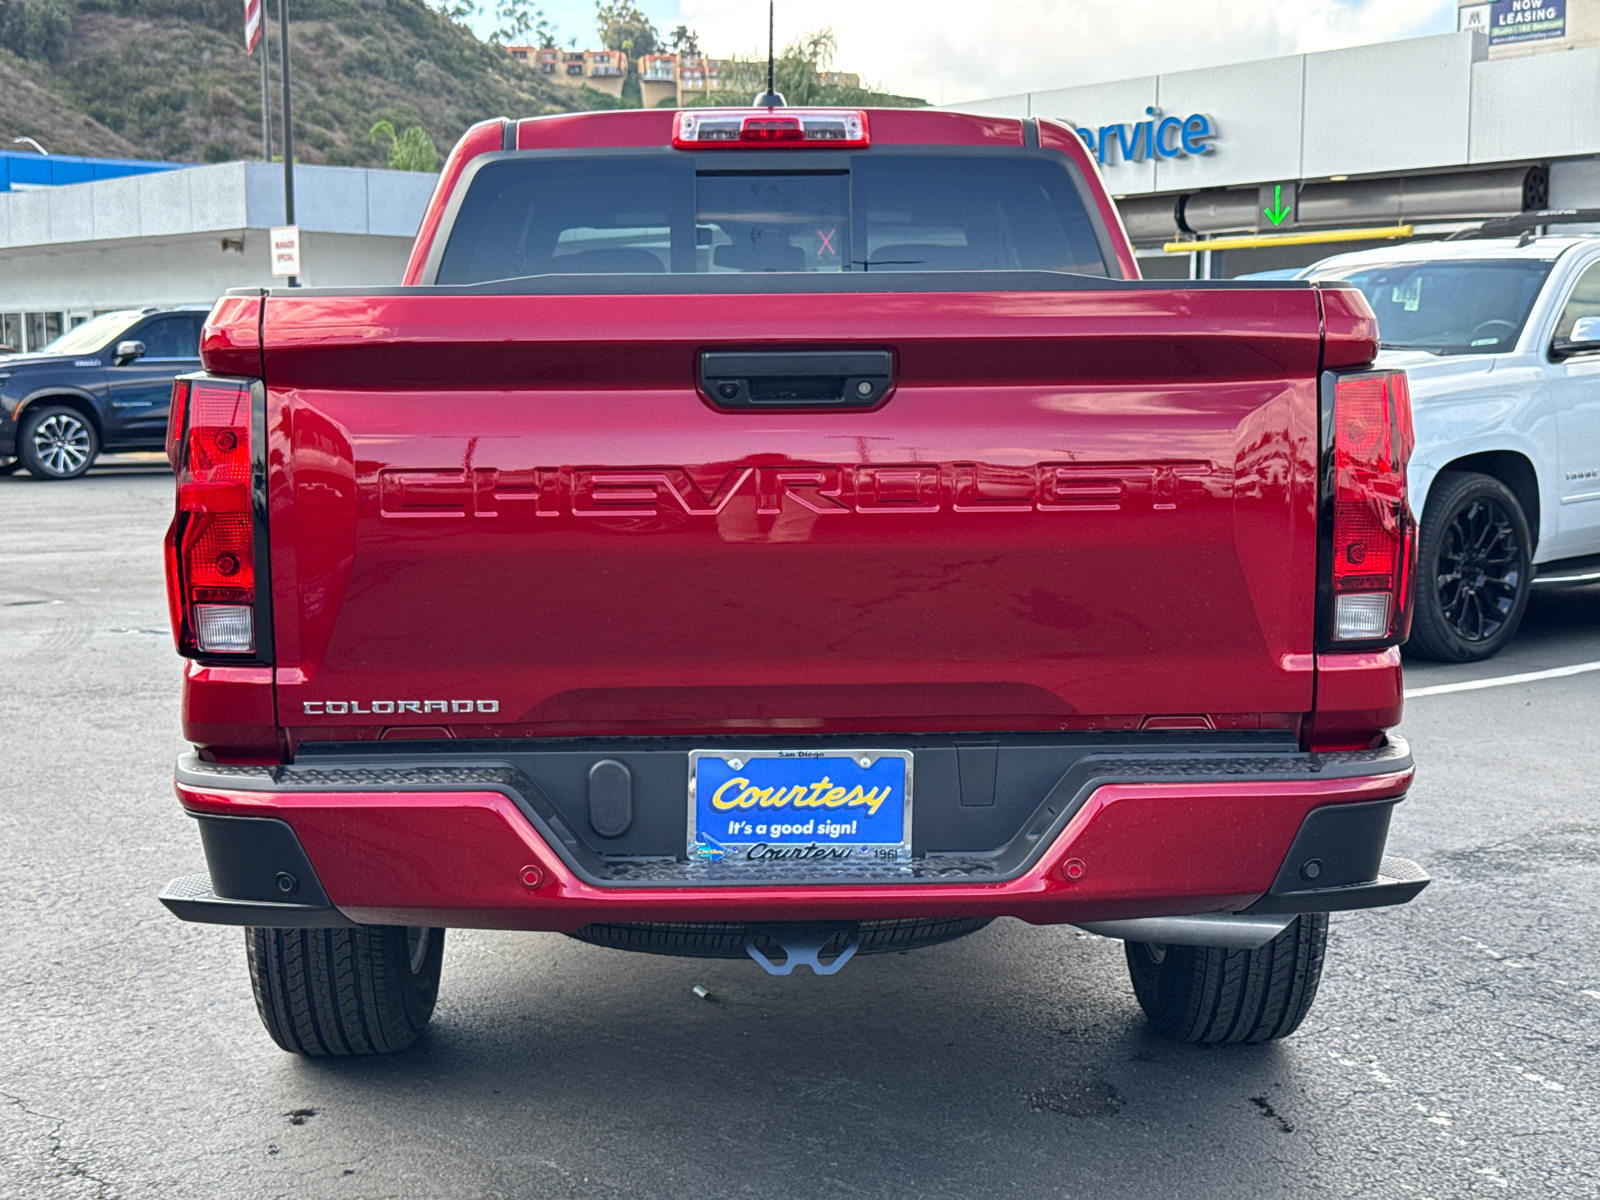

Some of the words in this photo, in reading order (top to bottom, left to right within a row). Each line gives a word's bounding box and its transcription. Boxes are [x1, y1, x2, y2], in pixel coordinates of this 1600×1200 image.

[1499, 6, 1557, 25] LEASING
[1512, 0, 1543, 12] NOW
[1075, 106, 1210, 163] rvice
[379, 461, 1212, 518] CHEVROLET
[302, 699, 500, 715] COLORADO
[798, 751, 825, 759] Diego
[711, 775, 892, 815] Courtesy
[728, 821, 753, 835] It's
[755, 822, 767, 835] a
[770, 819, 815, 838] good
[816, 820, 857, 838] sign!
[746, 841, 853, 860] Courtesy
[873, 848, 898, 859] 1961
